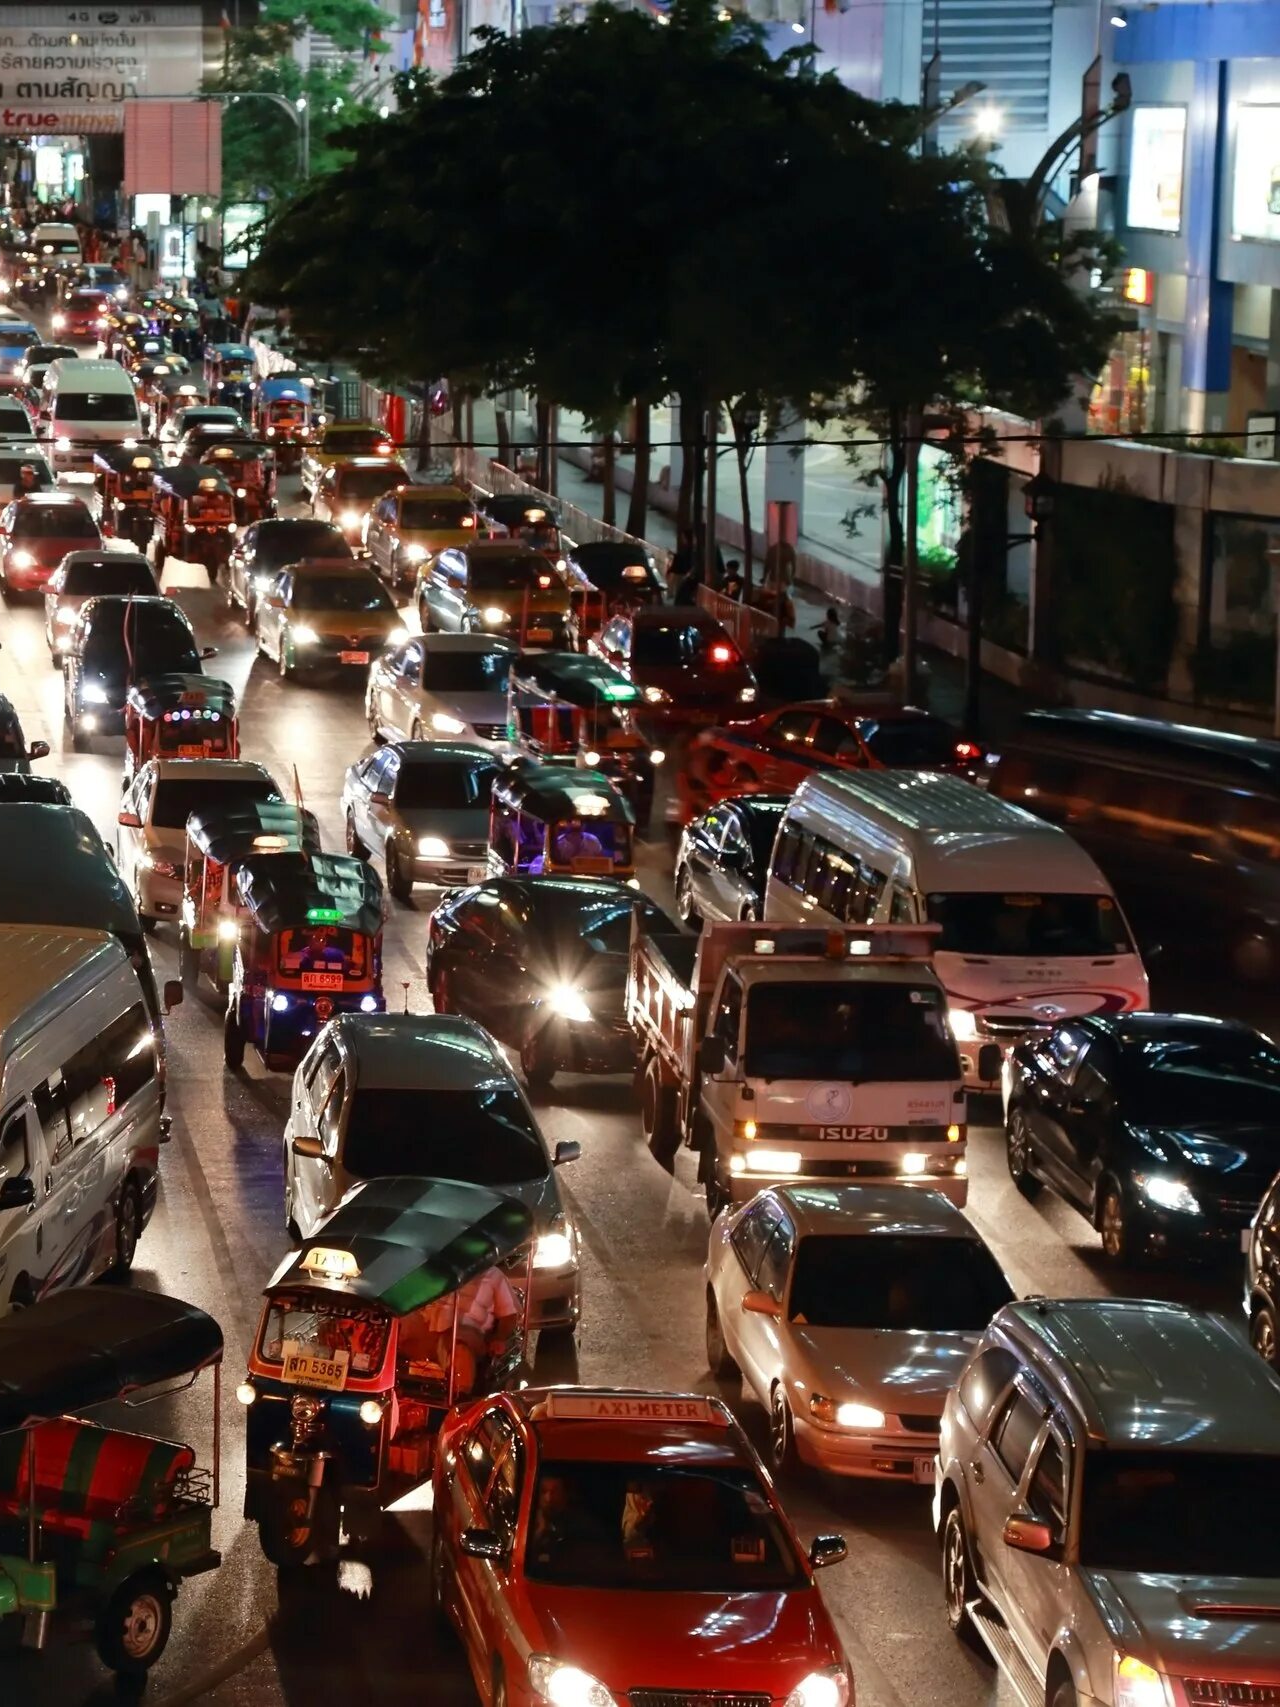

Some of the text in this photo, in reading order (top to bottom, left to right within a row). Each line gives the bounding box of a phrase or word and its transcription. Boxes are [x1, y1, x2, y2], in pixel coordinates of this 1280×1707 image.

[2, 109, 59, 126] true
[819, 1127, 888, 1140] ISUZU
[312, 1359, 343, 1379] 5365
[591, 1402, 699, 1417] AXI-METER
